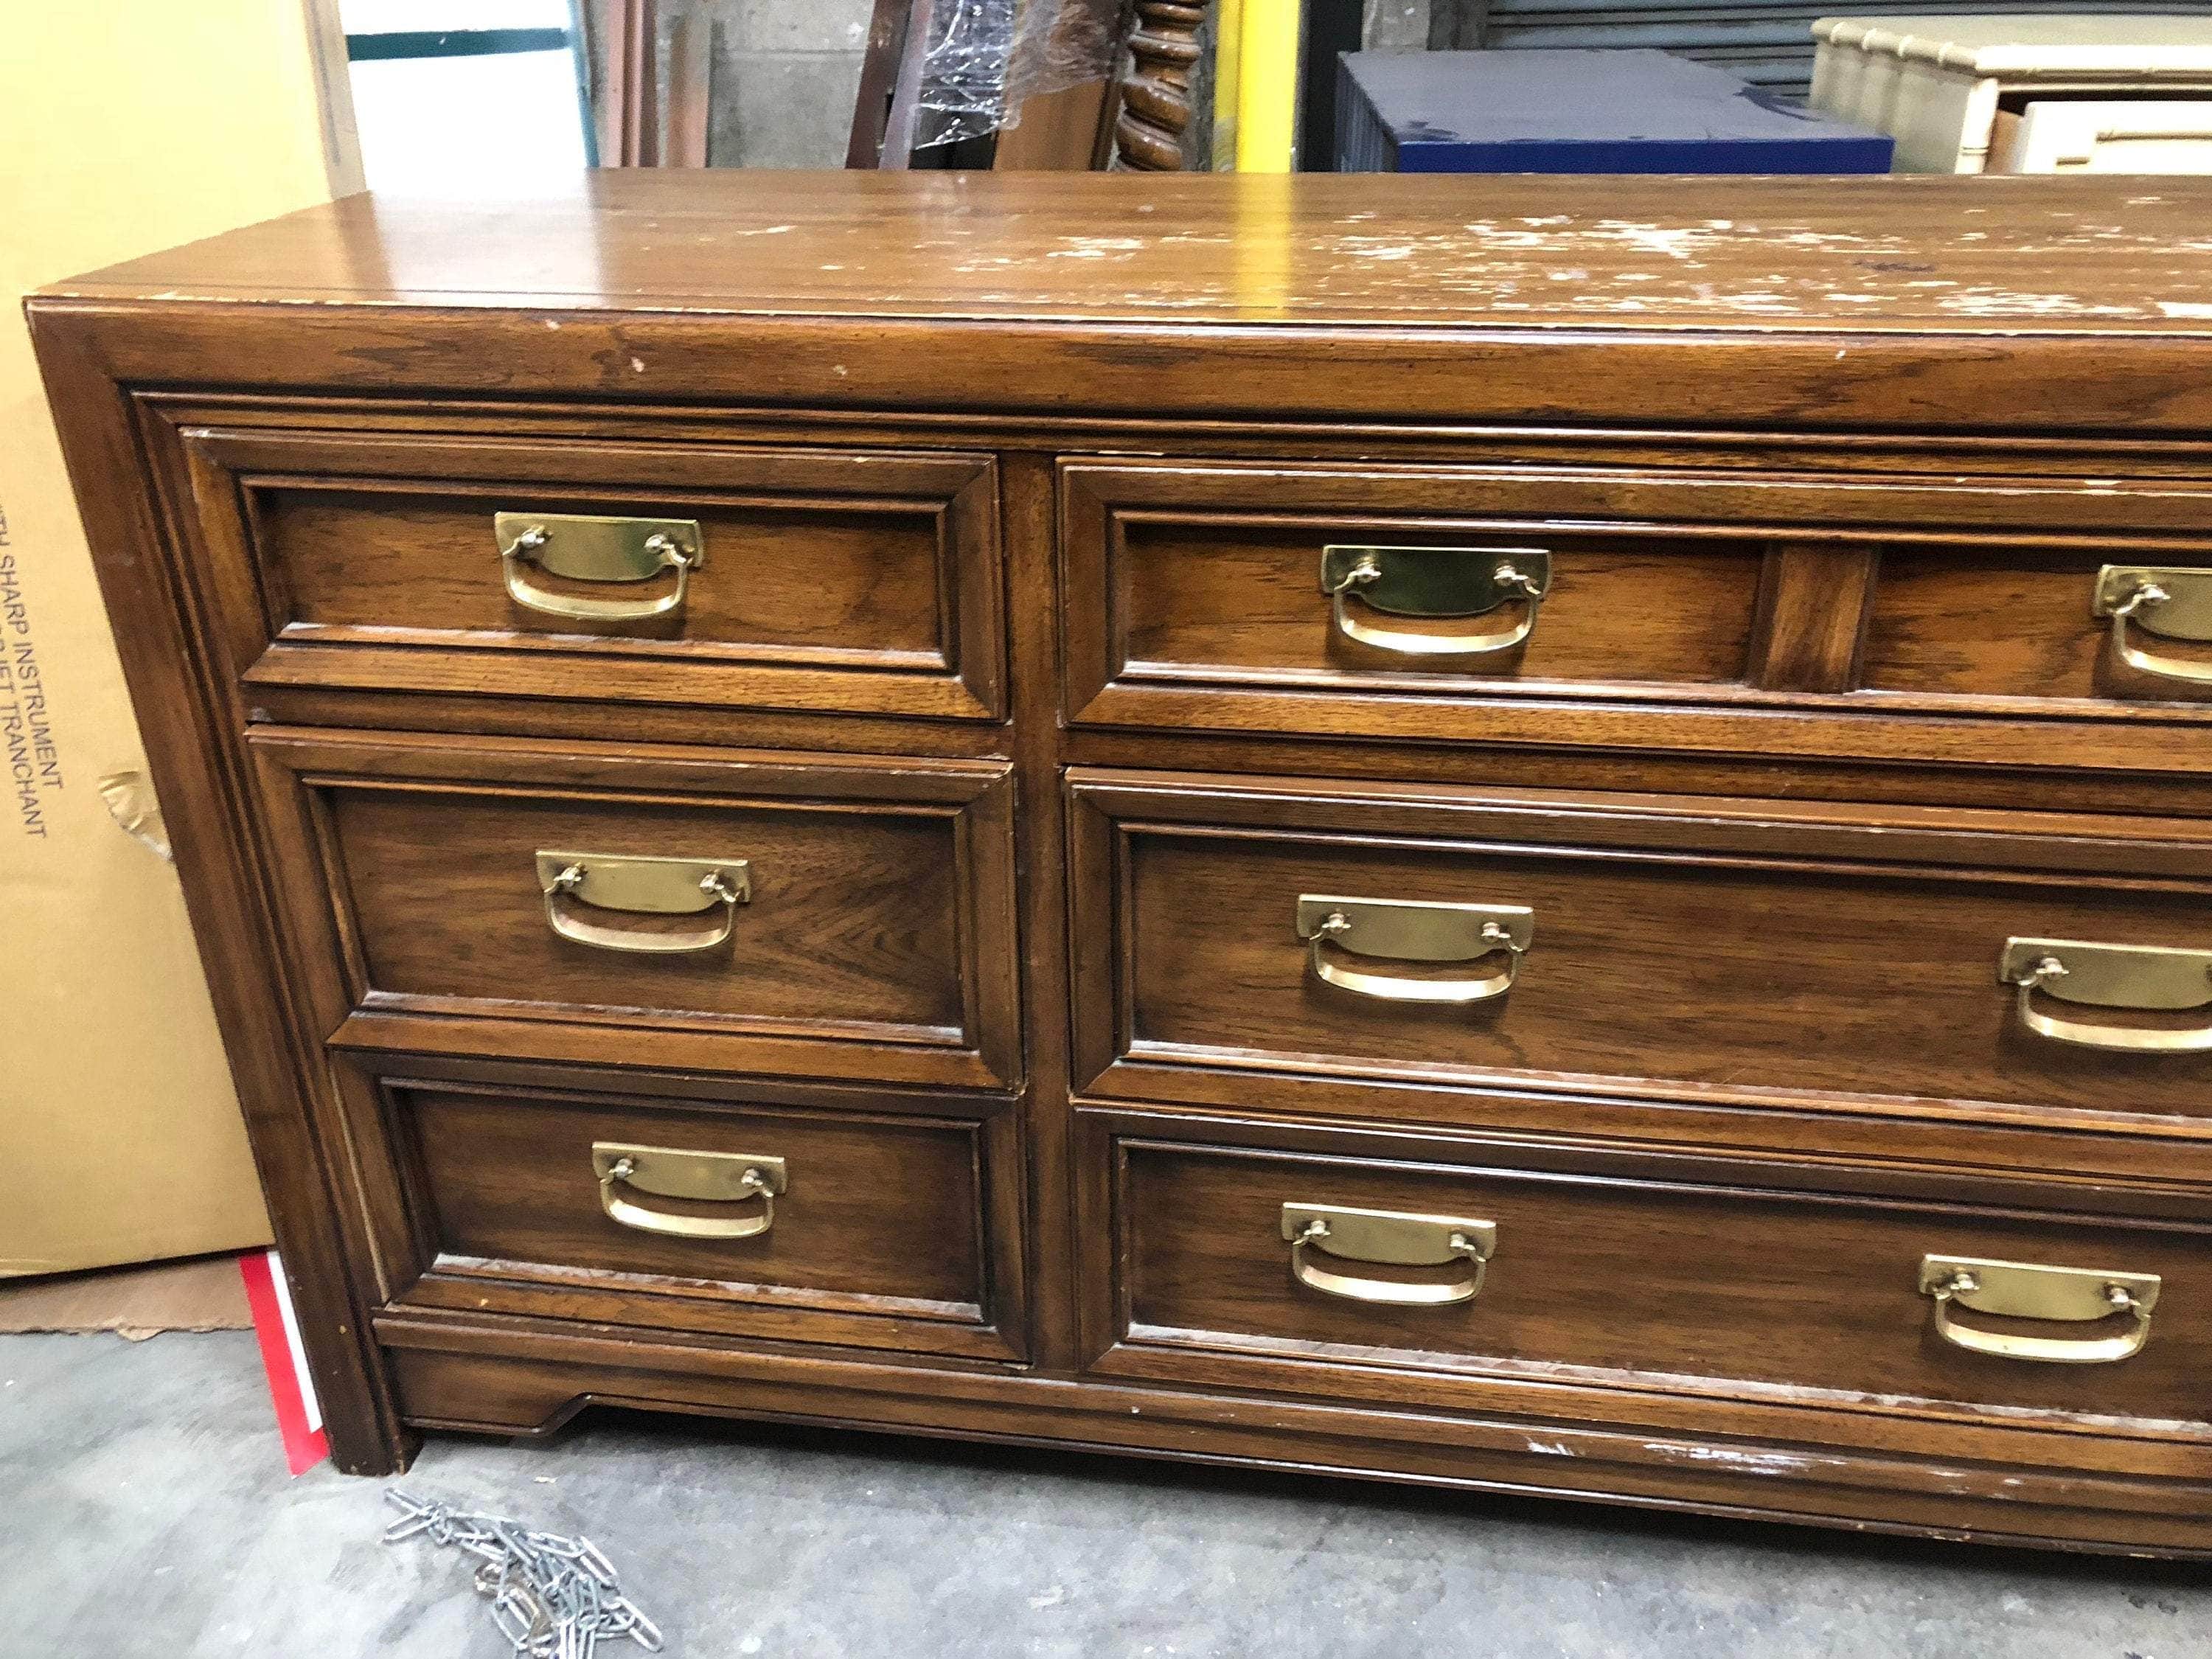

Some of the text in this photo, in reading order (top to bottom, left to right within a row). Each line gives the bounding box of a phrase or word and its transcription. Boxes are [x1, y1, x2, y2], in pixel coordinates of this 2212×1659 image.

[0, 555, 29, 635] SHARP
[0, 701, 46, 838] TRANCHANT
[13, 641, 63, 789] INSTRUMENT
